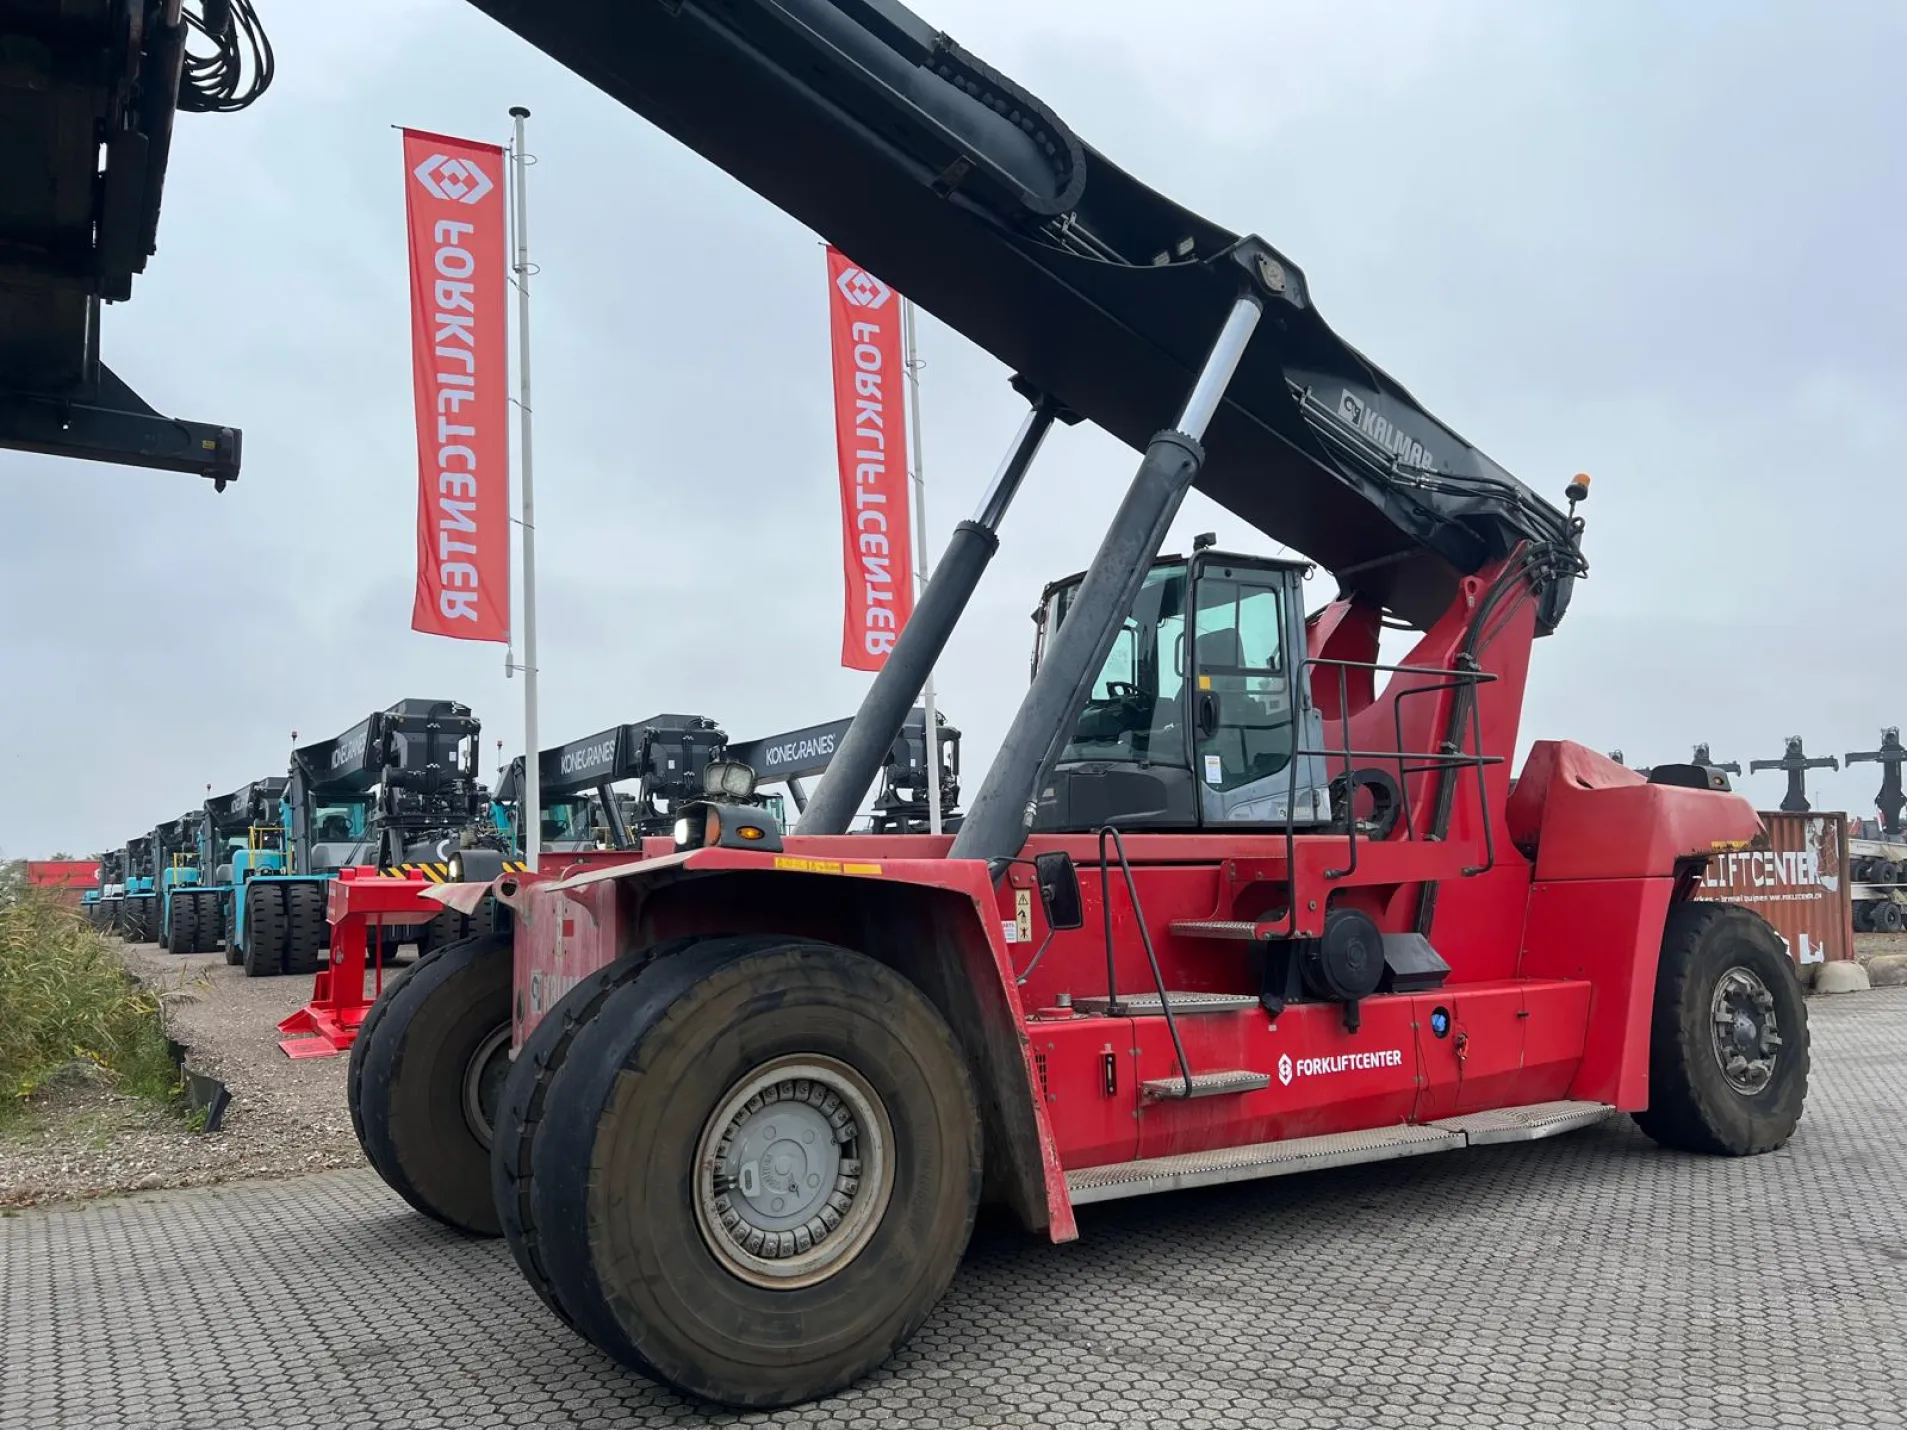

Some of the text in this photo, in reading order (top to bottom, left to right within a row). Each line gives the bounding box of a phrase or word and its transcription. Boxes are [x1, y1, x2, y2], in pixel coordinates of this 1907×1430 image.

[1362, 408, 1434, 470] KALMAR
[560, 739, 615, 775] KONECRANES
[766, 735, 835, 765] KONECRANES
[1700, 852, 1820, 888] LIFTCENTER
[1296, 1050, 1402, 1077] FORKLIFTCENTER
